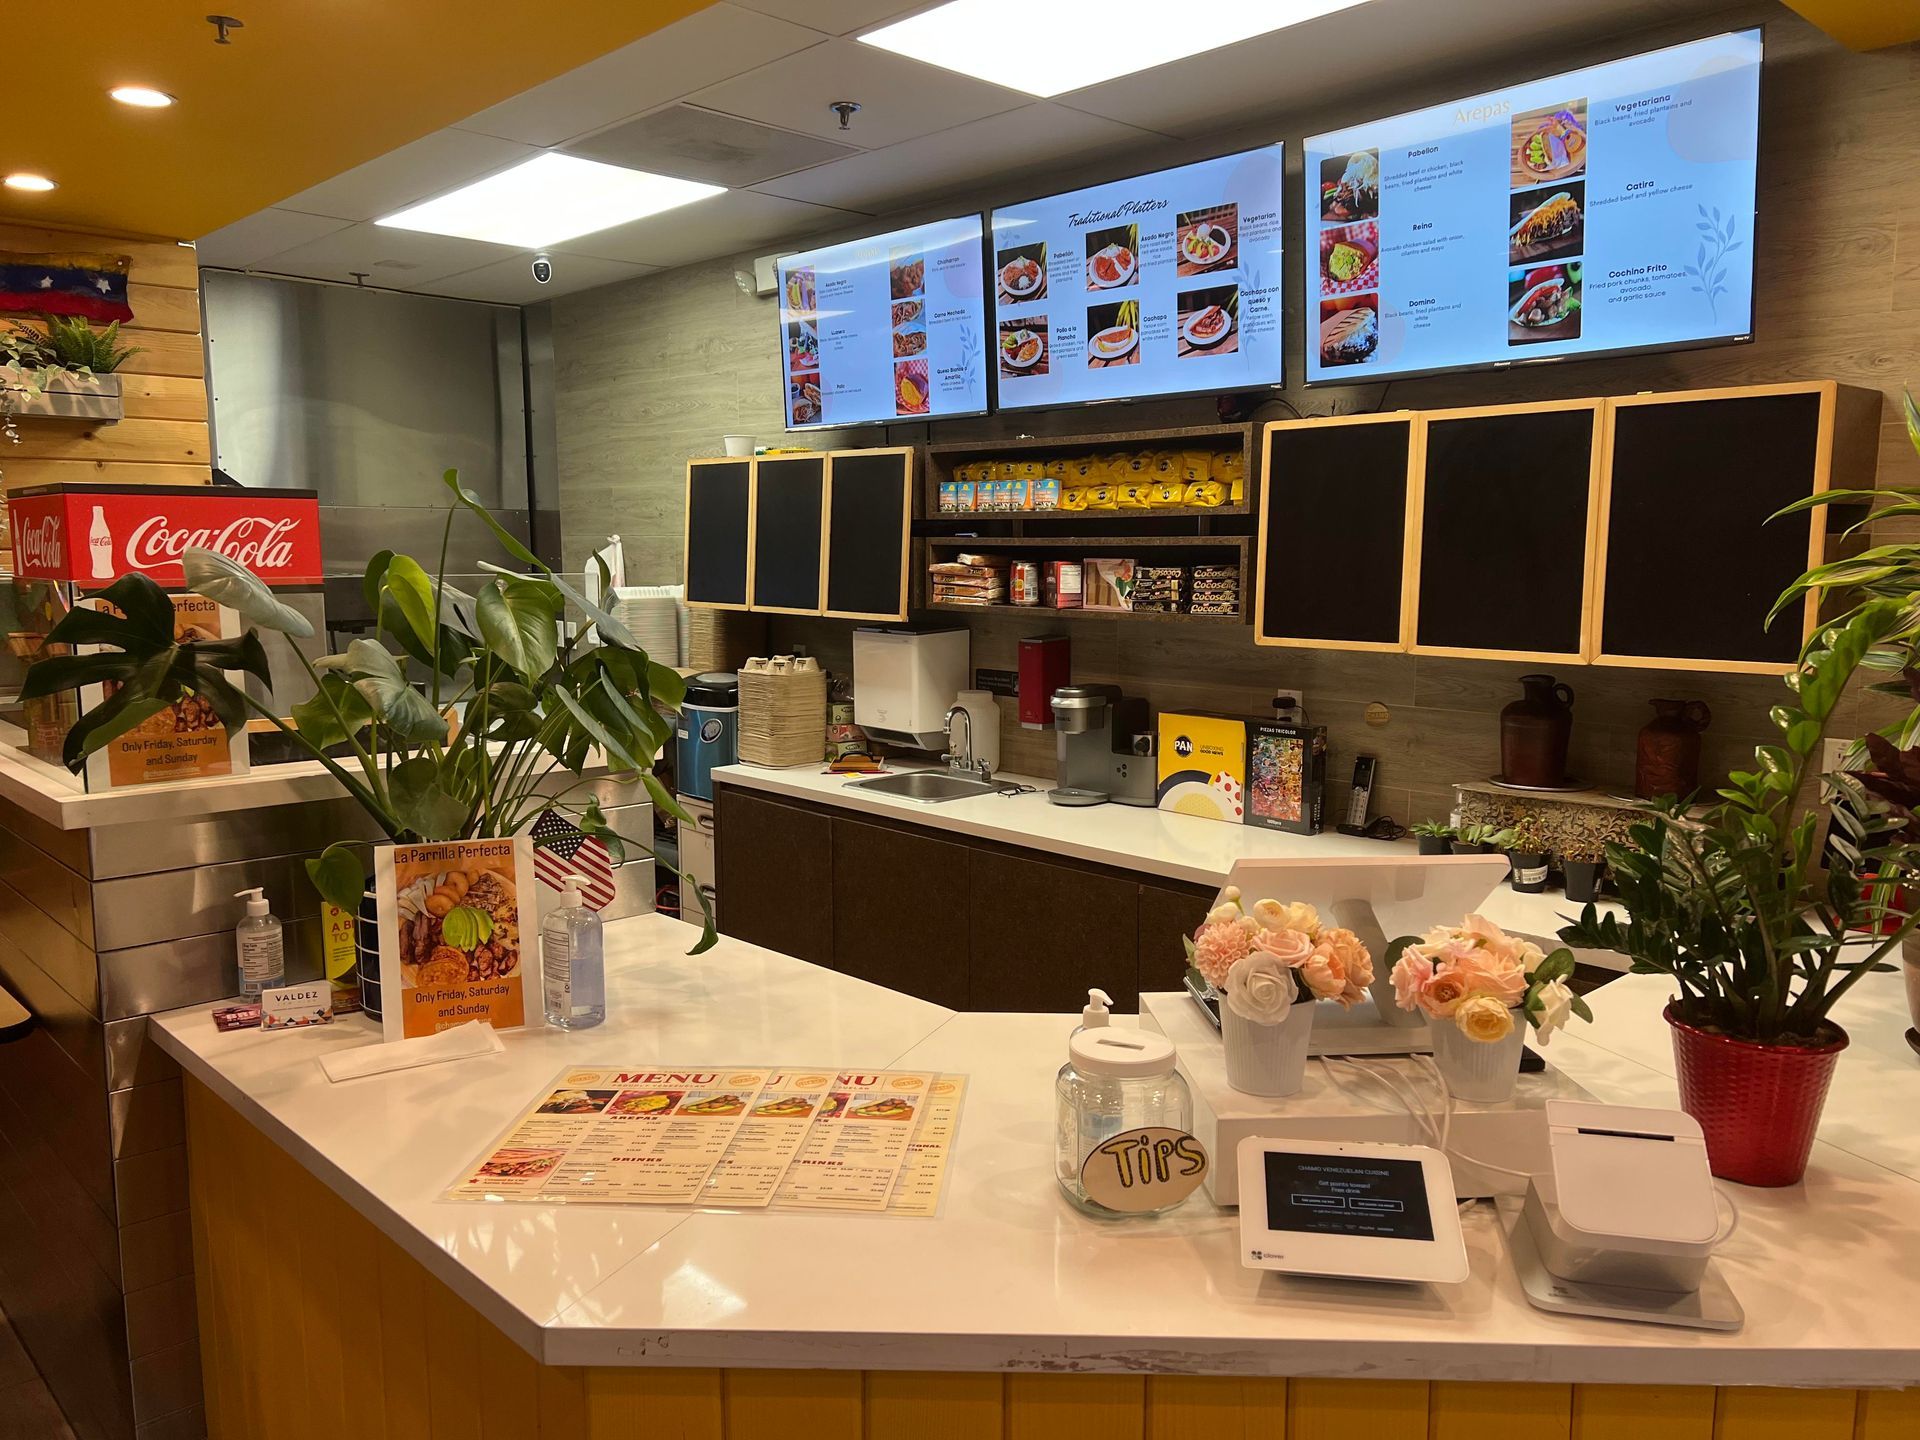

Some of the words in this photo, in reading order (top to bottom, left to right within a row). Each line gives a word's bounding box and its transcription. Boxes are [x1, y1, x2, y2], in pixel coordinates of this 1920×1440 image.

[1615, 95, 1671, 112] Vegetariana
[1634, 108, 1648, 117] fried
[1649, 102, 1678, 114] plantains
[1680, 100, 1692, 108] and
[1453, 100, 1511, 124] Arepas
[1628, 116, 1656, 127] avocado
[1626, 180, 1654, 191] Catira
[1620, 193, 1634, 202] beef
[1648, 188, 1668, 198] yellow
[1068, 203, 1124, 228] Traditional
[1123, 199, 1169, 216] Platters
[1242, 212, 1277, 223] Vegetarian
[1412, 222, 1433, 232] Reina
[1608, 266, 1645, 278] Cochino
[1646, 264, 1668, 273] Frito
[1607, 280, 1622, 288] pork
[1620, 284, 1652, 294] avocado
[1623, 293, 1643, 302] garlic
[1644, 290, 1666, 298] sauce
[1408, 298, 1436, 308] Domino
[23, 516, 61, 569] Coca-Cola
[126, 515, 301, 568] Coca-Cola
[172, 600, 216, 612] erfecta
[122, 742, 142, 754] Only
[176, 736, 217, 748] Saturday
[1174, 740, 1193, 753] PAN
[146, 757, 163, 766] and
[164, 753, 198, 764] Sunday
[394, 851, 408, 864] La
[411, 846, 456, 862] Parrilla
[458, 844, 510, 858] Perfecta
[276, 991, 318, 1002] VALDEZ
[416, 992, 435, 1004] Only
[437, 990, 467, 1001] Friday,
[469, 984, 510, 998] Saturday
[438, 1007, 454, 1018] and
[457, 1004, 490, 1016] Sunday
[612, 1073, 719, 1084] MENU
[837, 1075, 880, 1086] NU
